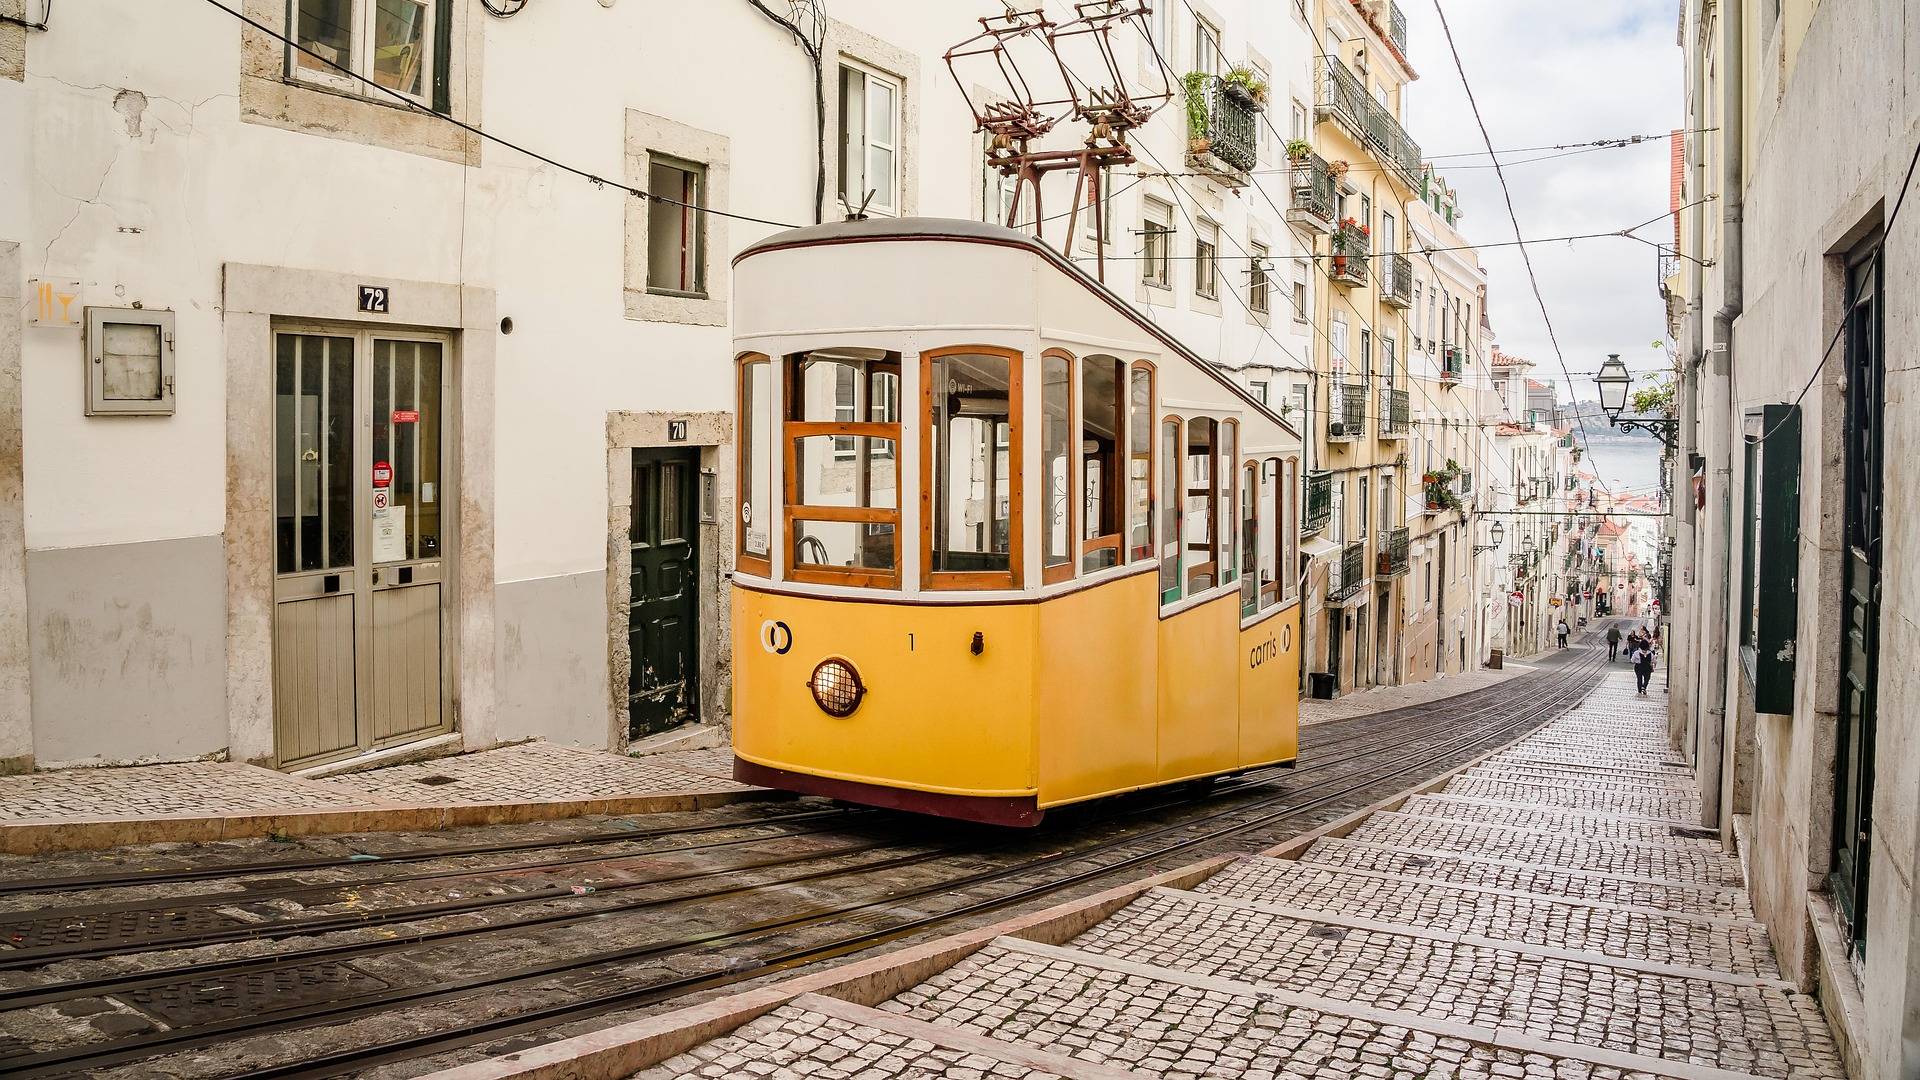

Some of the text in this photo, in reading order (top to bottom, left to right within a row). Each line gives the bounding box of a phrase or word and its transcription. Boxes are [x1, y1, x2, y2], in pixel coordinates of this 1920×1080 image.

[364, 287, 384, 311] 72
[672, 422, 684, 439] 70
[908, 633, 914, 652] 1
[1250, 631, 1277, 669] carris
